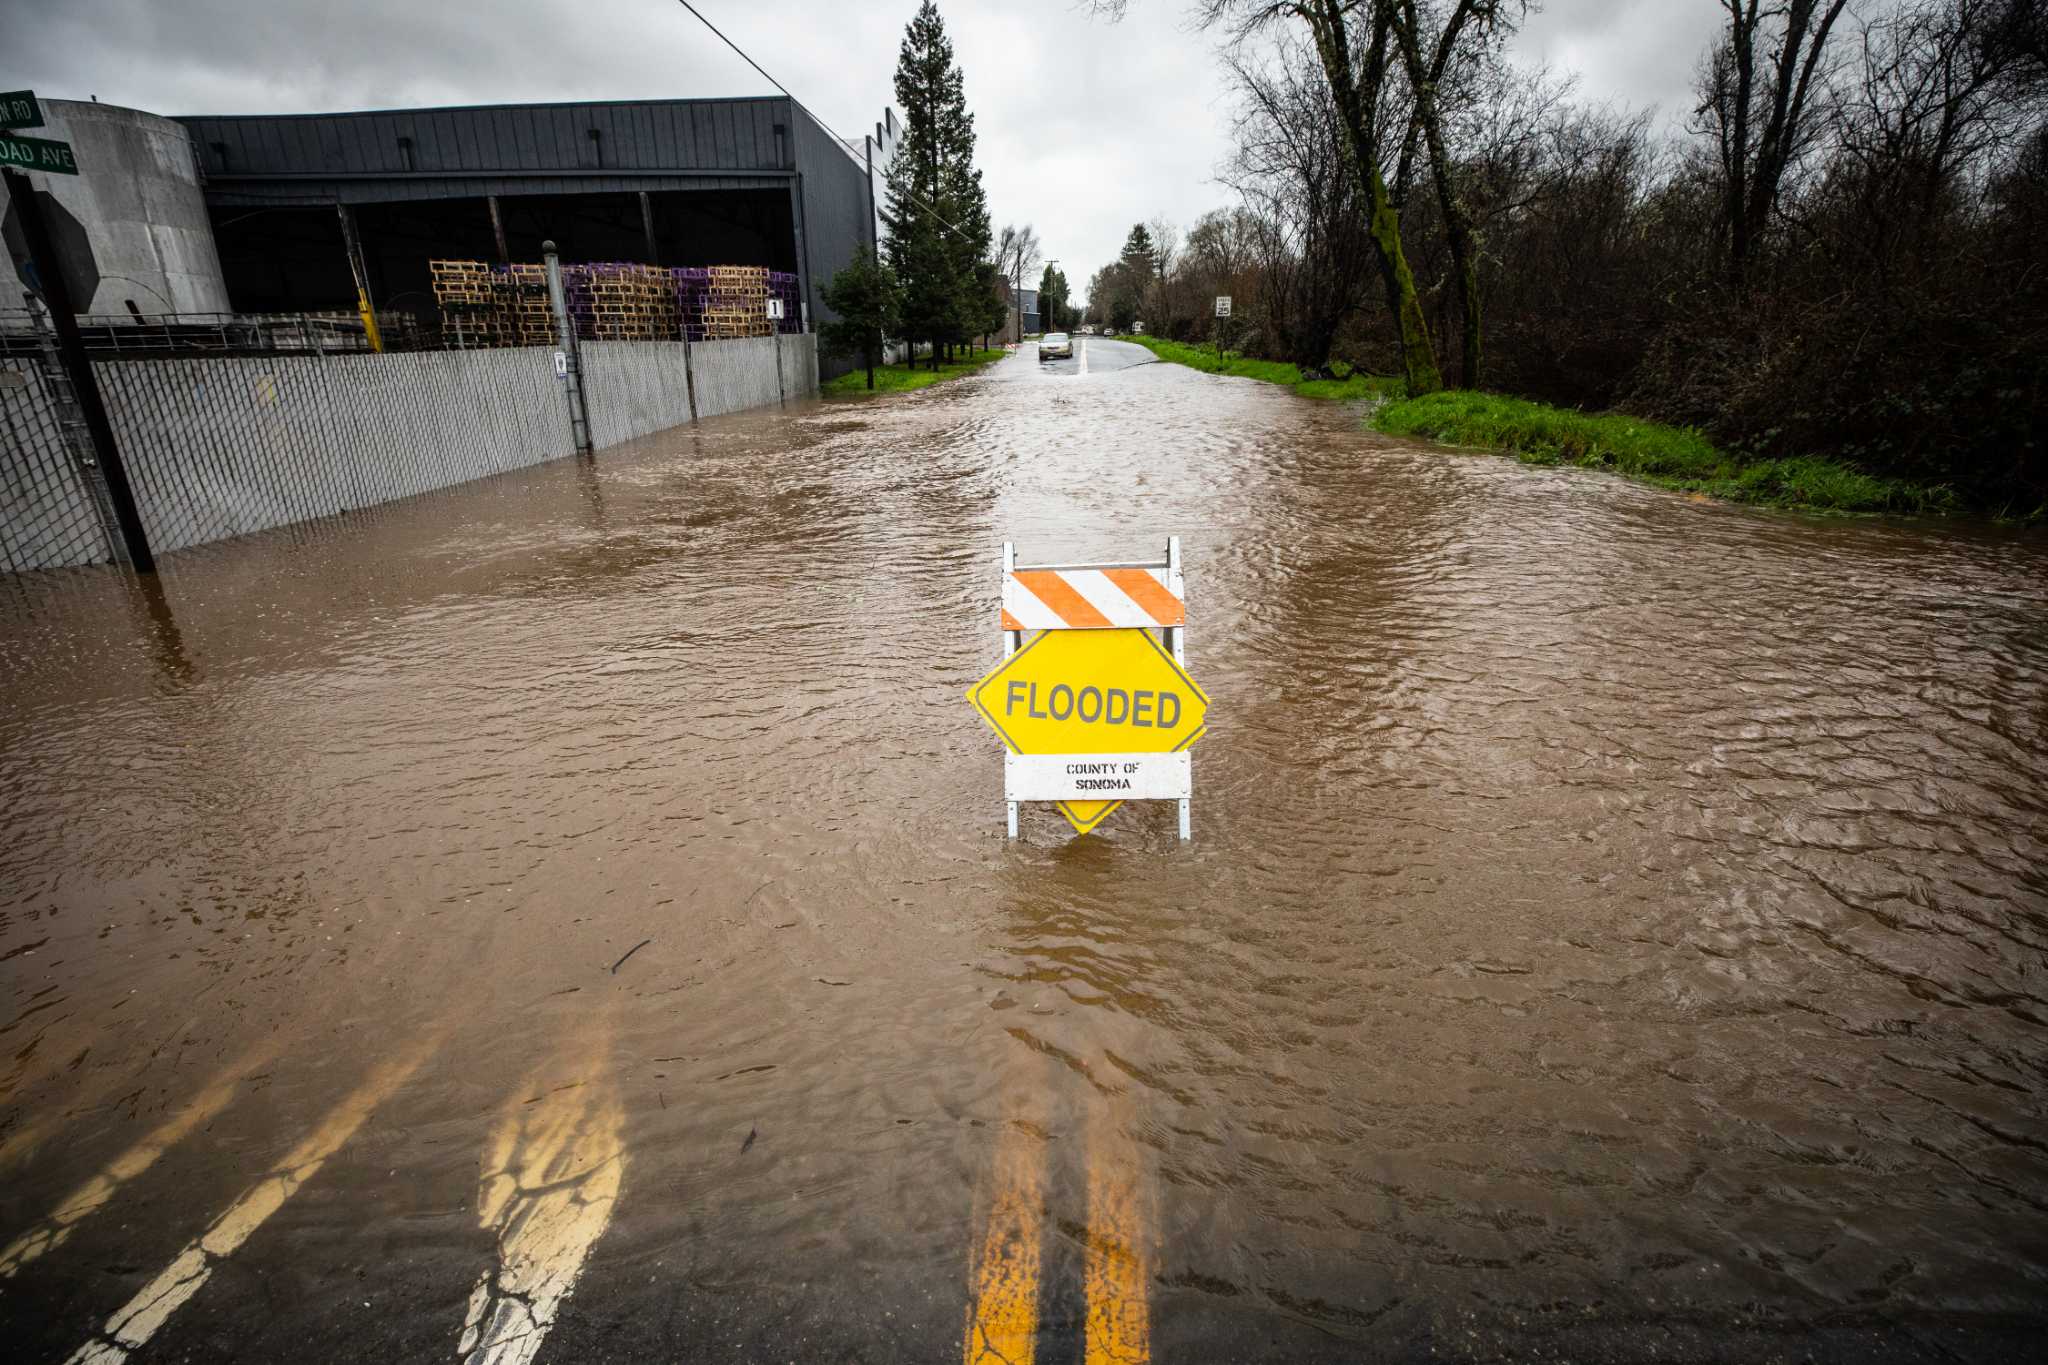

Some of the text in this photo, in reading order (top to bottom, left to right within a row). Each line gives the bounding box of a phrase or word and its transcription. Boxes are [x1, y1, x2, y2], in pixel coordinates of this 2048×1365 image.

[11, 100, 32, 120] RD
[41, 146, 75, 167] AVE
[772, 301, 777, 315] 1
[1218, 307, 1229, 315] 25
[1006, 680, 1181, 729] FLOODED
[1066, 762, 1141, 775] COUNTY OF
[1075, 778, 1132, 790] SONOMA
